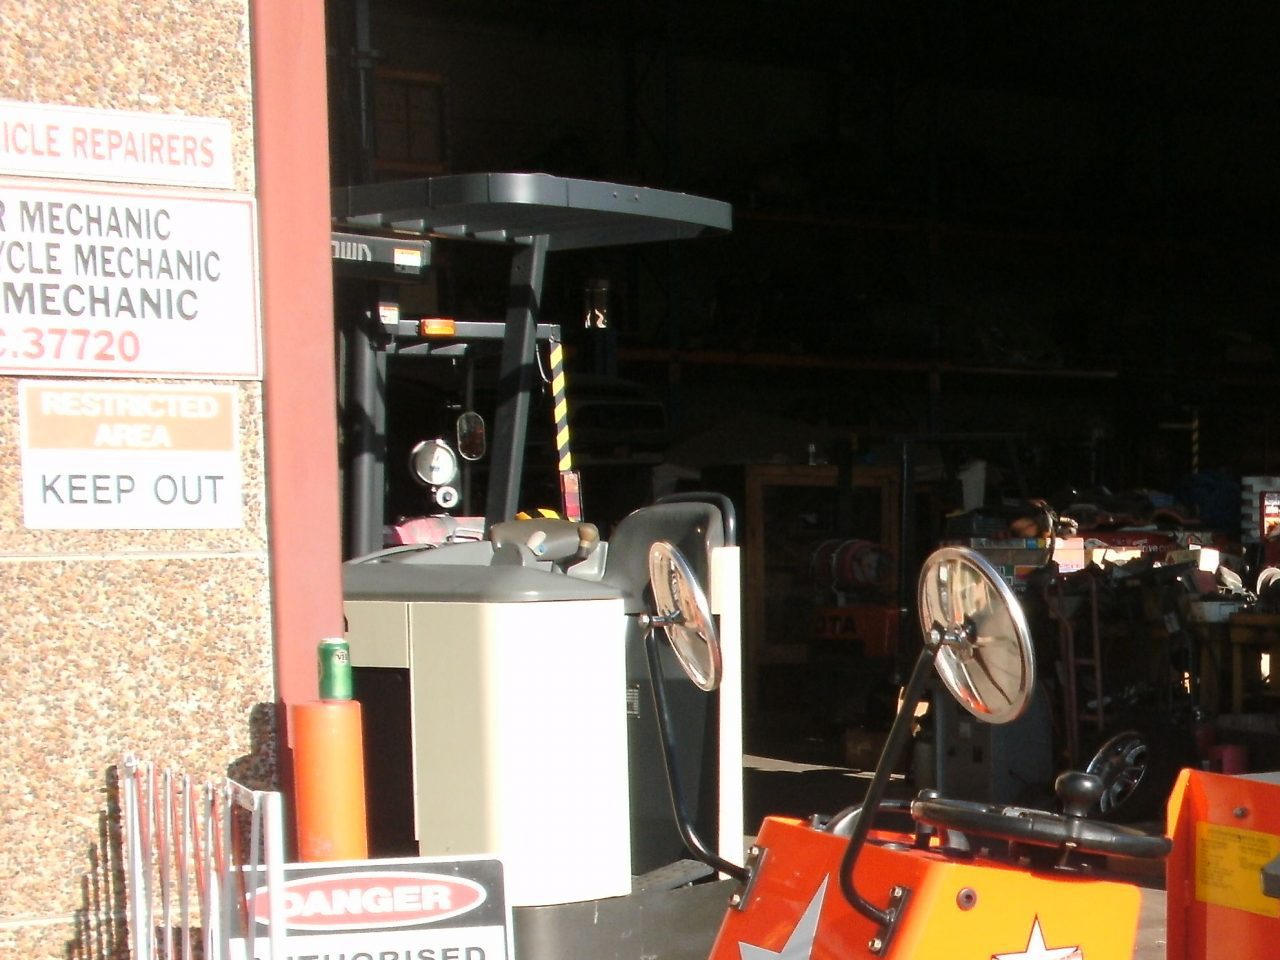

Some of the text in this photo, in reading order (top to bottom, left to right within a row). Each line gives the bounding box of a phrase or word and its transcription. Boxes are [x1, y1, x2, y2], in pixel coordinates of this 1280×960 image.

[72, 127, 214, 168] REPAIRERS
[20, 200, 171, 241] MECHANIC
[74, 243, 221, 282] MECHANIC
[3, 281, 199, 321] MECHANIC
[41, 391, 220, 419] RESTRICTED
[94, 423, 174, 449] AREA
[41, 474, 224, 505] KEEP OUT
[282, 884, 453, 917] DANGER
